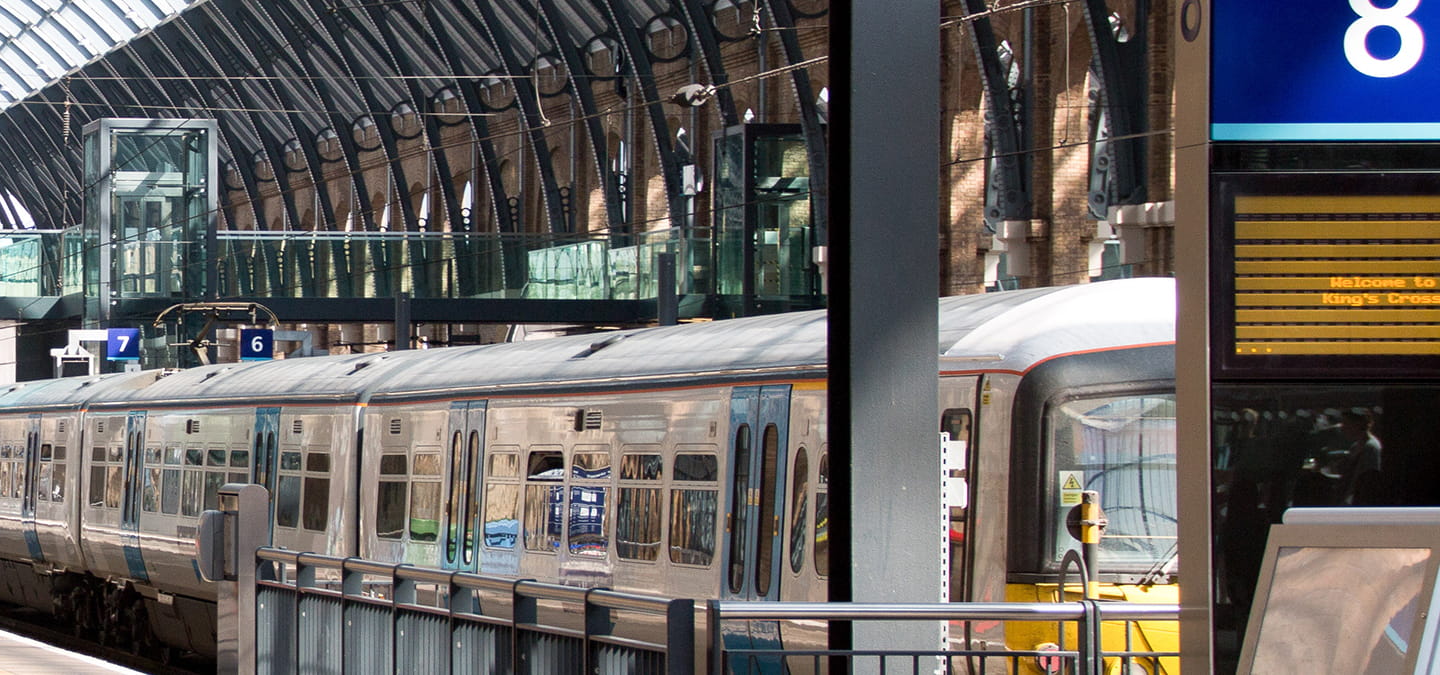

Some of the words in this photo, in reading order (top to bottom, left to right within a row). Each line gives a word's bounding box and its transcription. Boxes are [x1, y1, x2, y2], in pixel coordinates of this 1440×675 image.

[1343, 0, 1426, 78] 8
[1330, 276, 1406, 288] Welcome
[1414, 276, 1436, 288] to
[1322, 293, 1379, 306] King's
[1387, 292, 1440, 304] Cross
[117, 336, 130, 353] 7
[251, 336, 264, 353] 6
